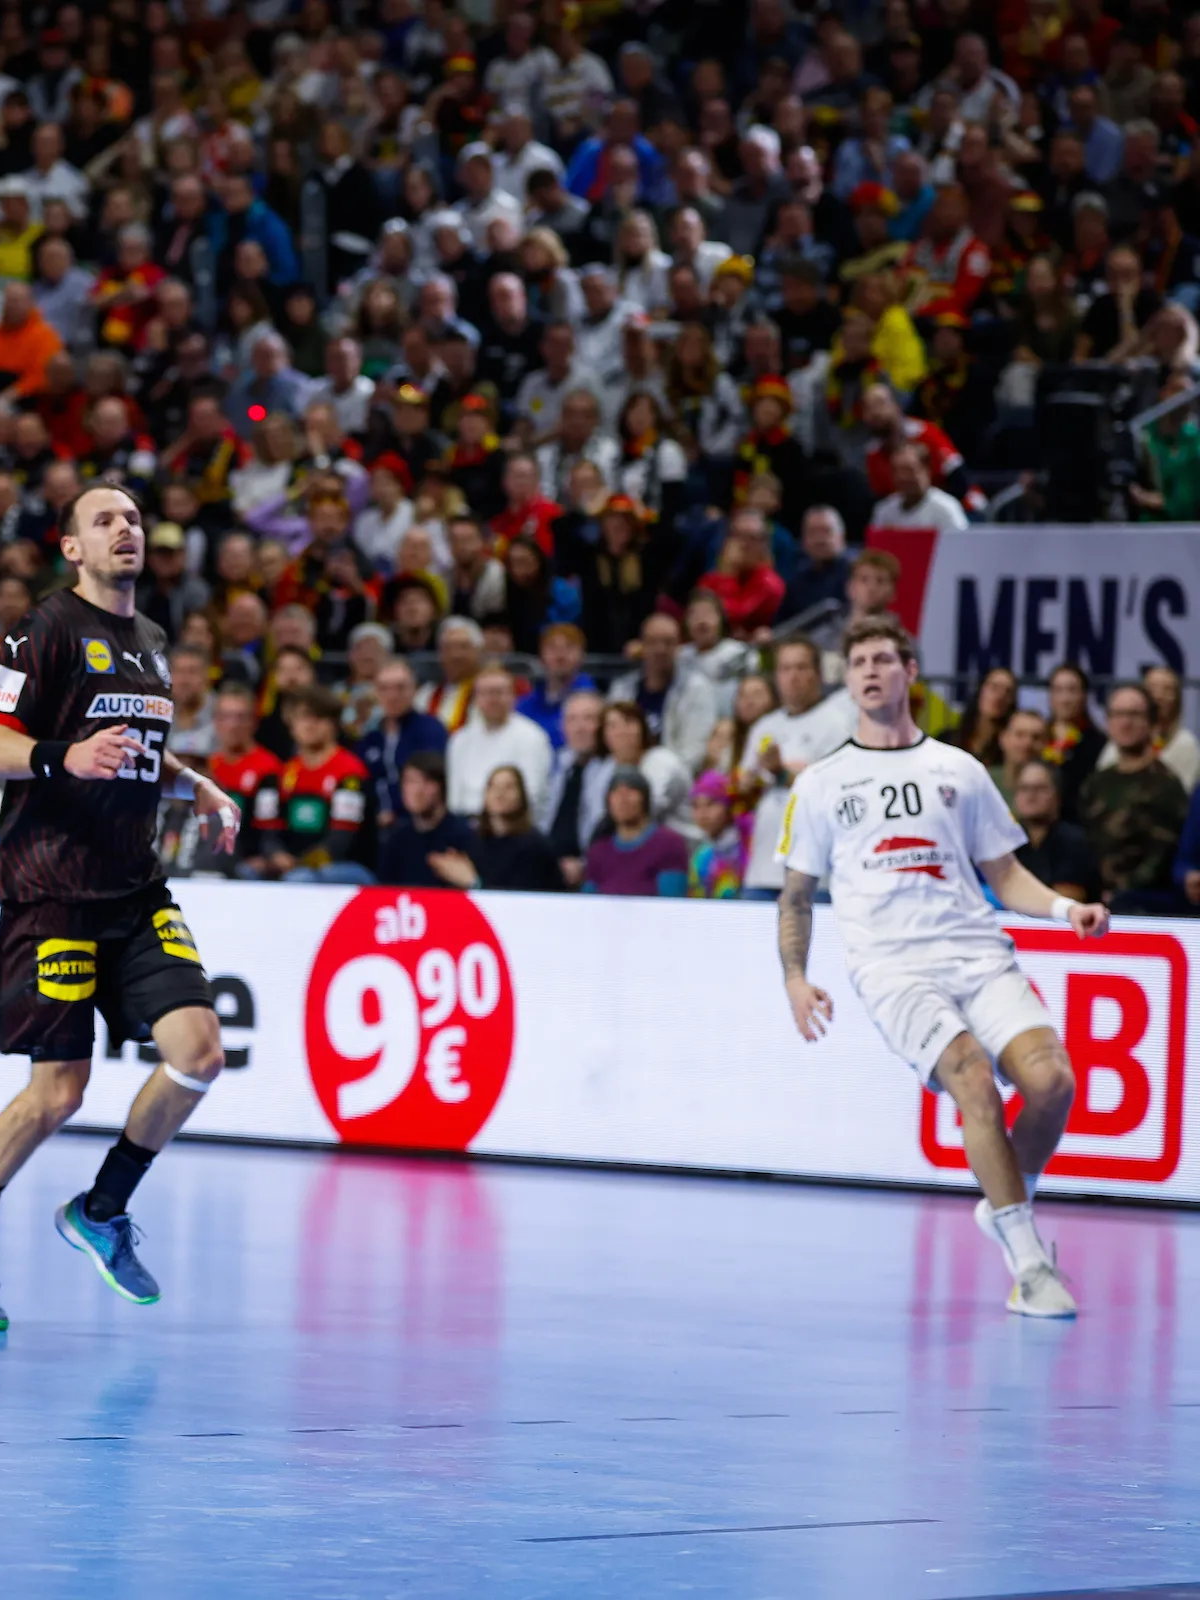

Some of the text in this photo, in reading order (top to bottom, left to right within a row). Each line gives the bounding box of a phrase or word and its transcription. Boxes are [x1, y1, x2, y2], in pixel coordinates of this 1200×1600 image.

[117, 727, 163, 783] 25
[880, 782, 922, 819] 20
[374, 893, 427, 945] ab
